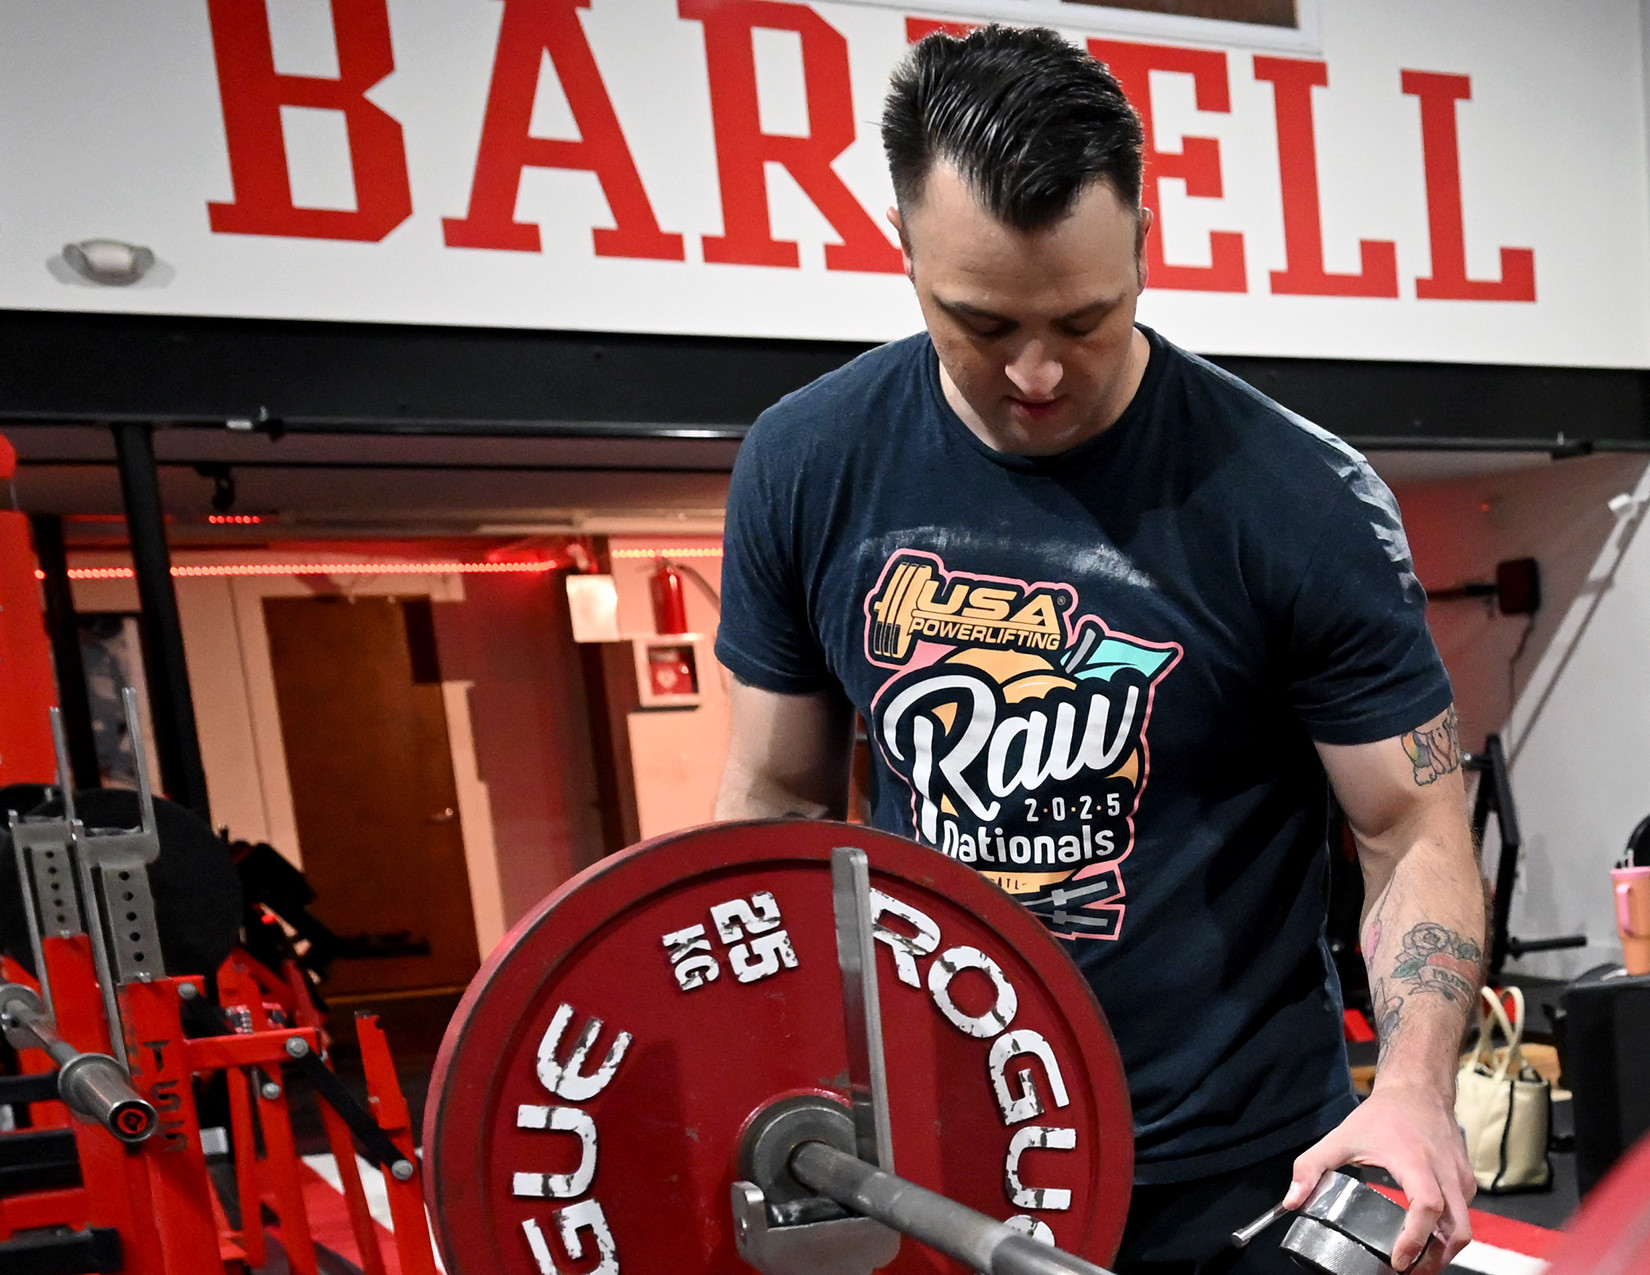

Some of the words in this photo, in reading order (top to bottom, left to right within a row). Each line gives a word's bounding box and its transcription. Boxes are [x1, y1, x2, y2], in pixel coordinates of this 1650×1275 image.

[207, 0, 1536, 303] BARELL
[908, 618, 1061, 650] POWERLIFTING
[916, 580, 1061, 634] USA
[883, 674, 1139, 844] Raw
[661, 923, 721, 992] KG
[710, 890, 800, 984] 25
